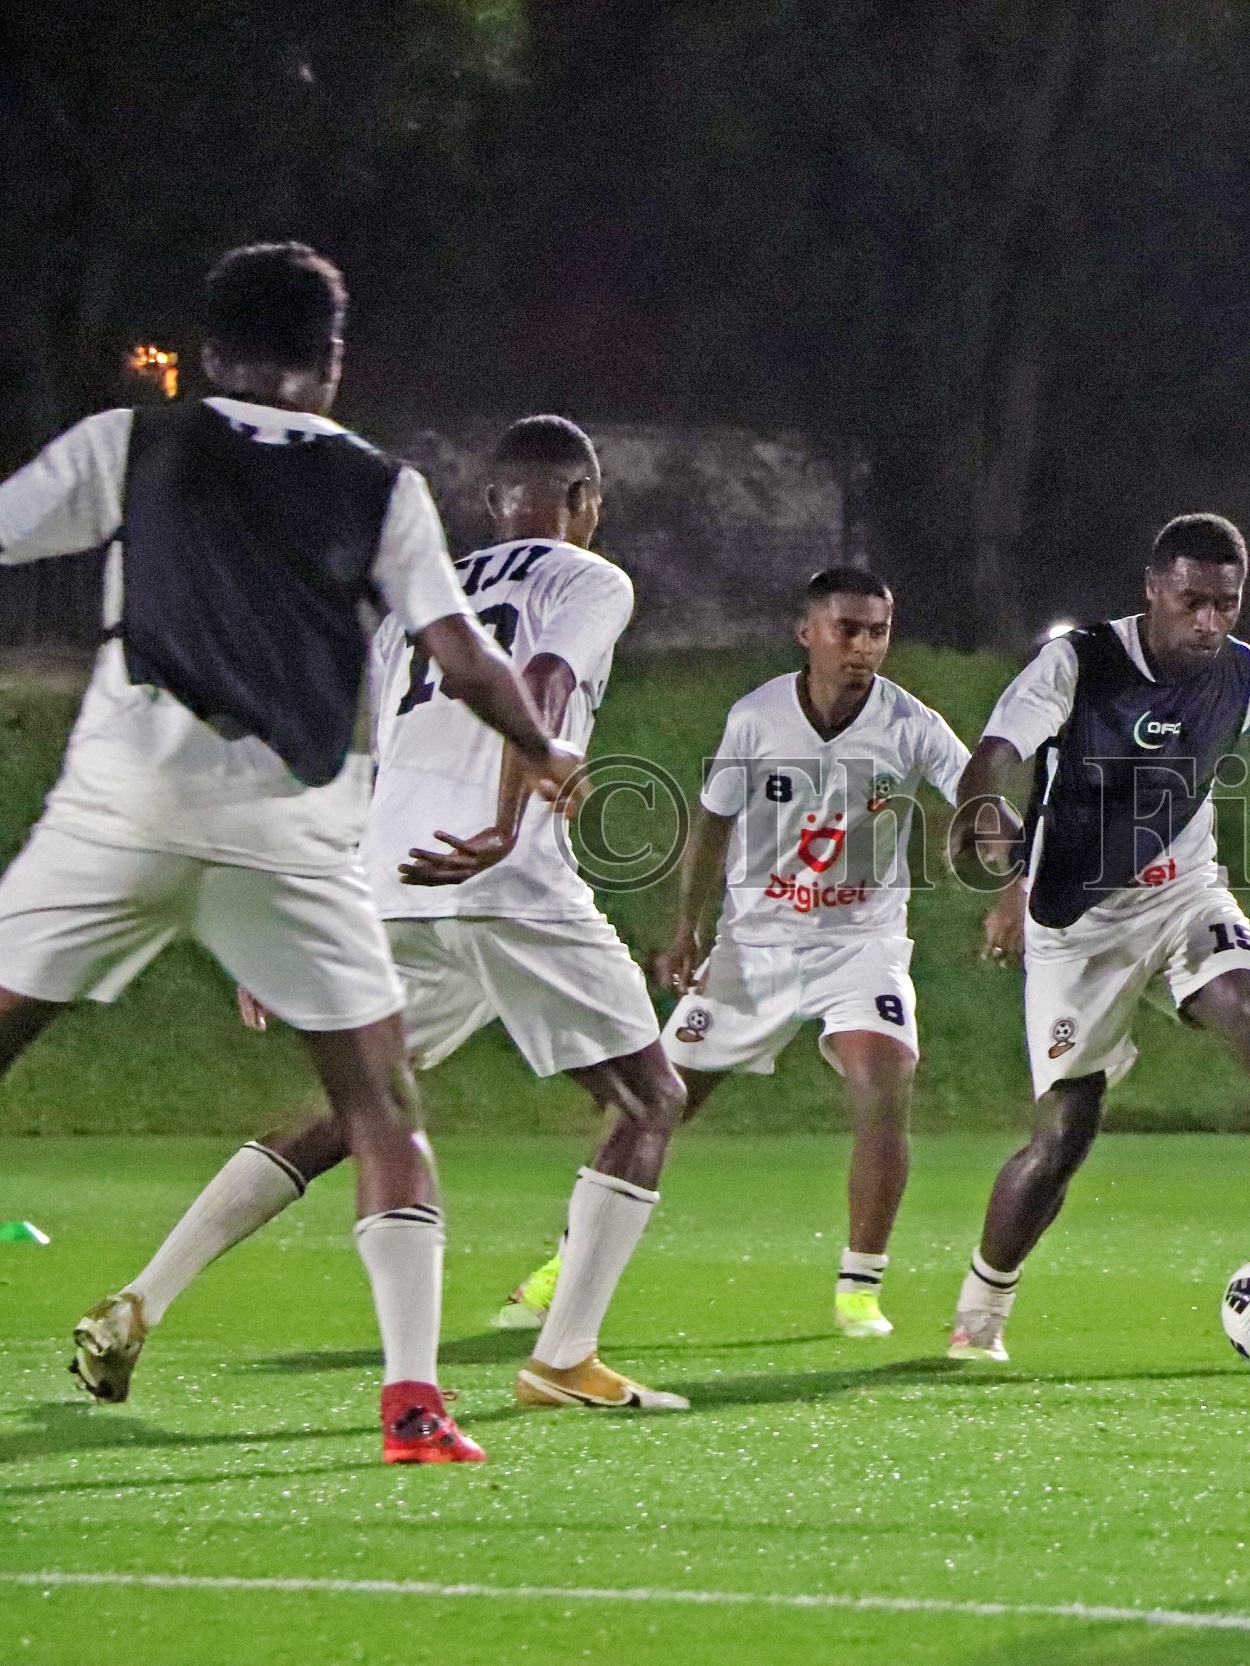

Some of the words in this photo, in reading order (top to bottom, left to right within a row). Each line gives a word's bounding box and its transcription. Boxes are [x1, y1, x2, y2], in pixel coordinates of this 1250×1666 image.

[455, 545, 553, 597] IJI
[765, 774, 793, 803] 8
[764, 873, 868, 913] Digicel
[875, 994, 905, 1026] 8
